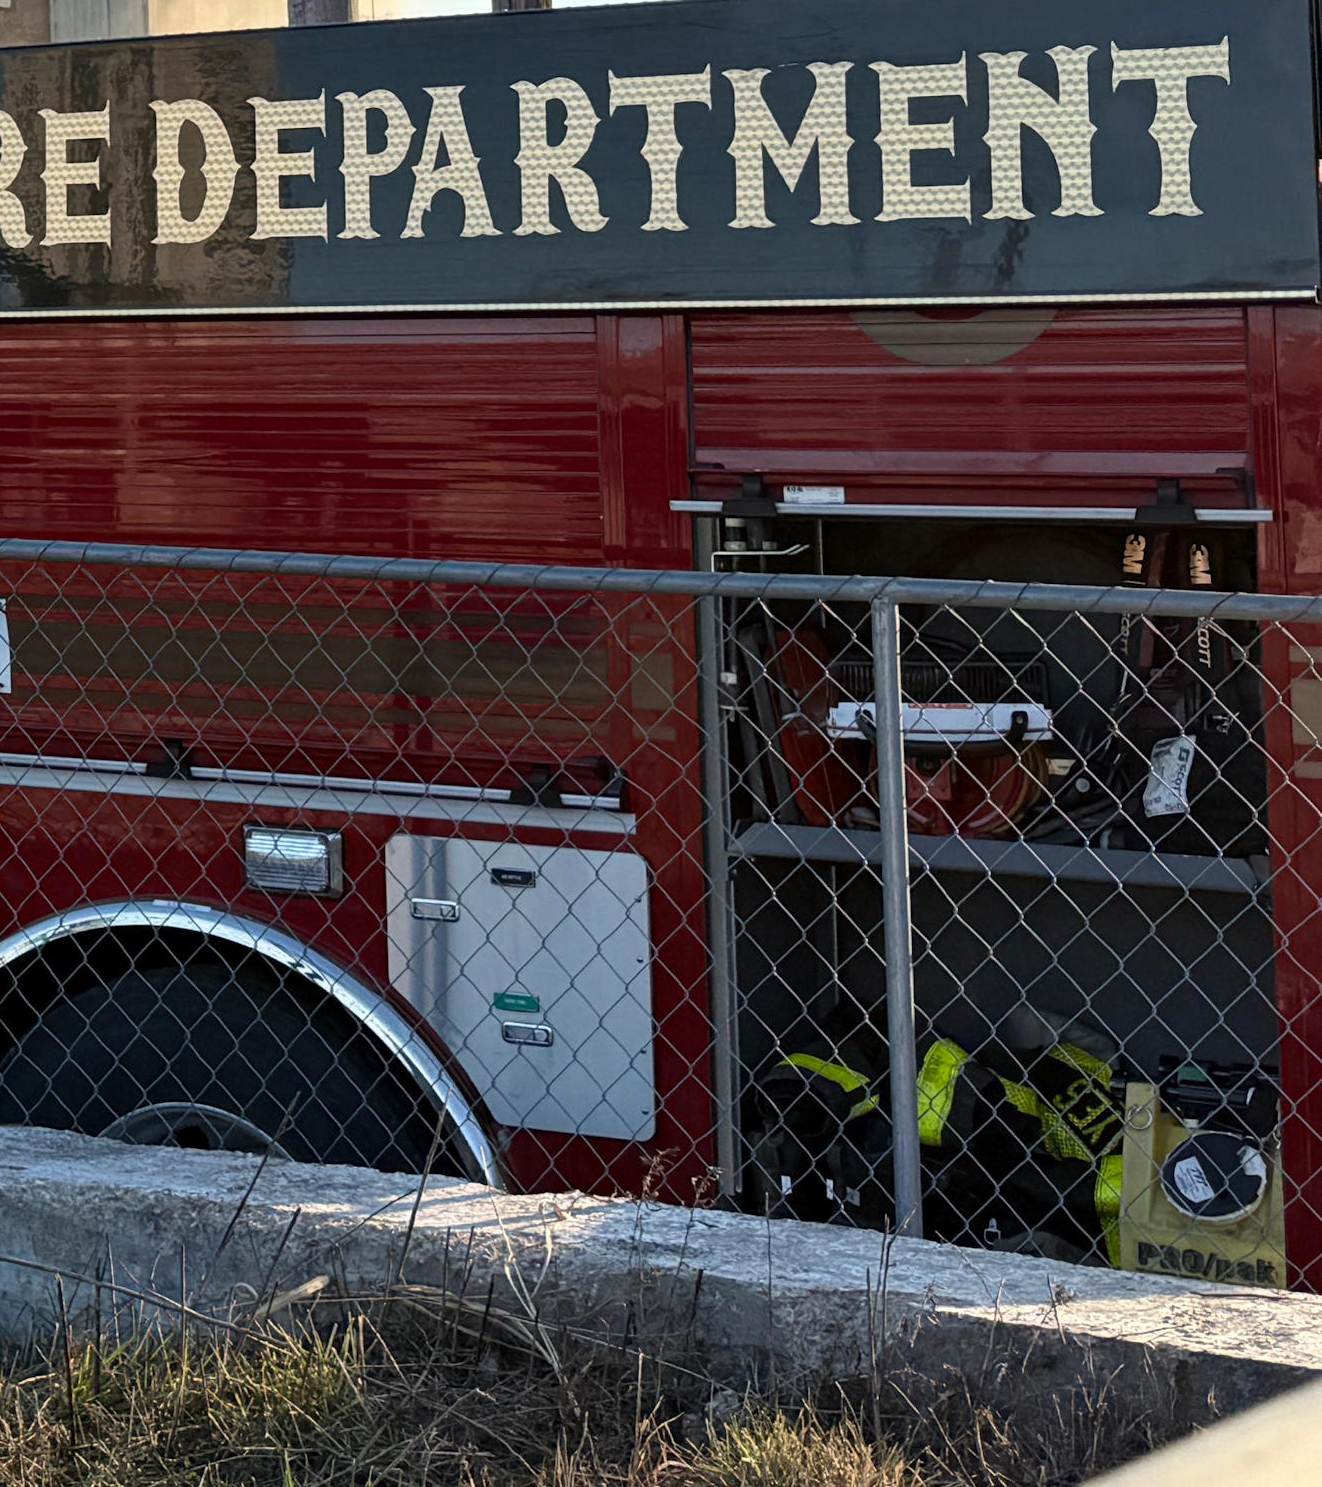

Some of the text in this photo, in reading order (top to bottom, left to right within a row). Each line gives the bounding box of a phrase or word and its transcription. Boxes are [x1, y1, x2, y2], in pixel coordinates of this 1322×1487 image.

[148, 35, 1232, 245] DEPARTMENT
[1122, 533, 1146, 575] 3M
[1189, 543, 1212, 585] 3M
